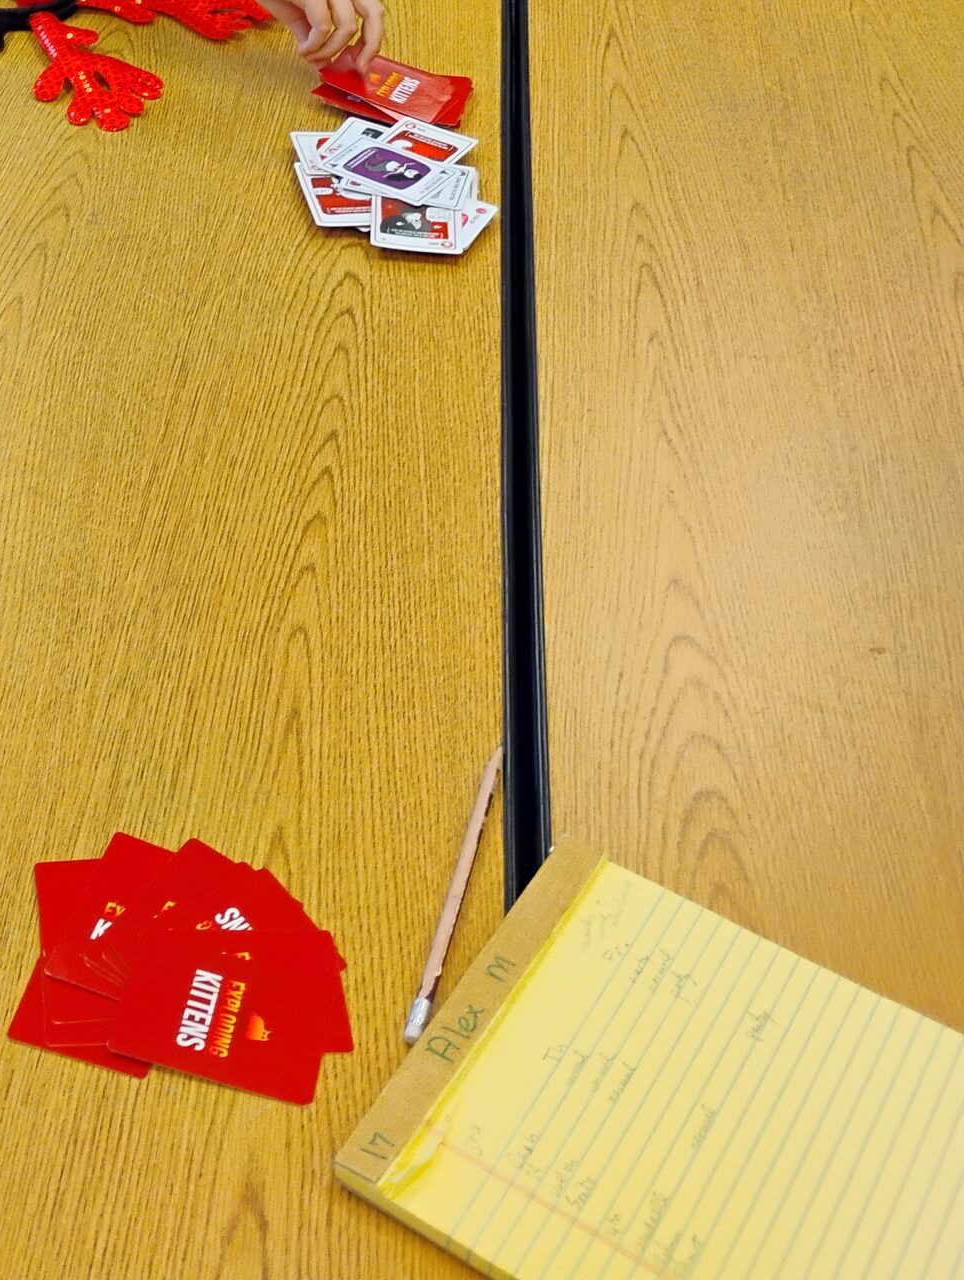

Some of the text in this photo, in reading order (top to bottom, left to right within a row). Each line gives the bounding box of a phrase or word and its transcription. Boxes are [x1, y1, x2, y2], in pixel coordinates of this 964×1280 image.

[388, 76, 421, 105] KITTENS
[176, 968, 224, 1051] KITTENS
[360, 1131, 395, 1161] 17
[425, 1004, 485, 1063] Alex
